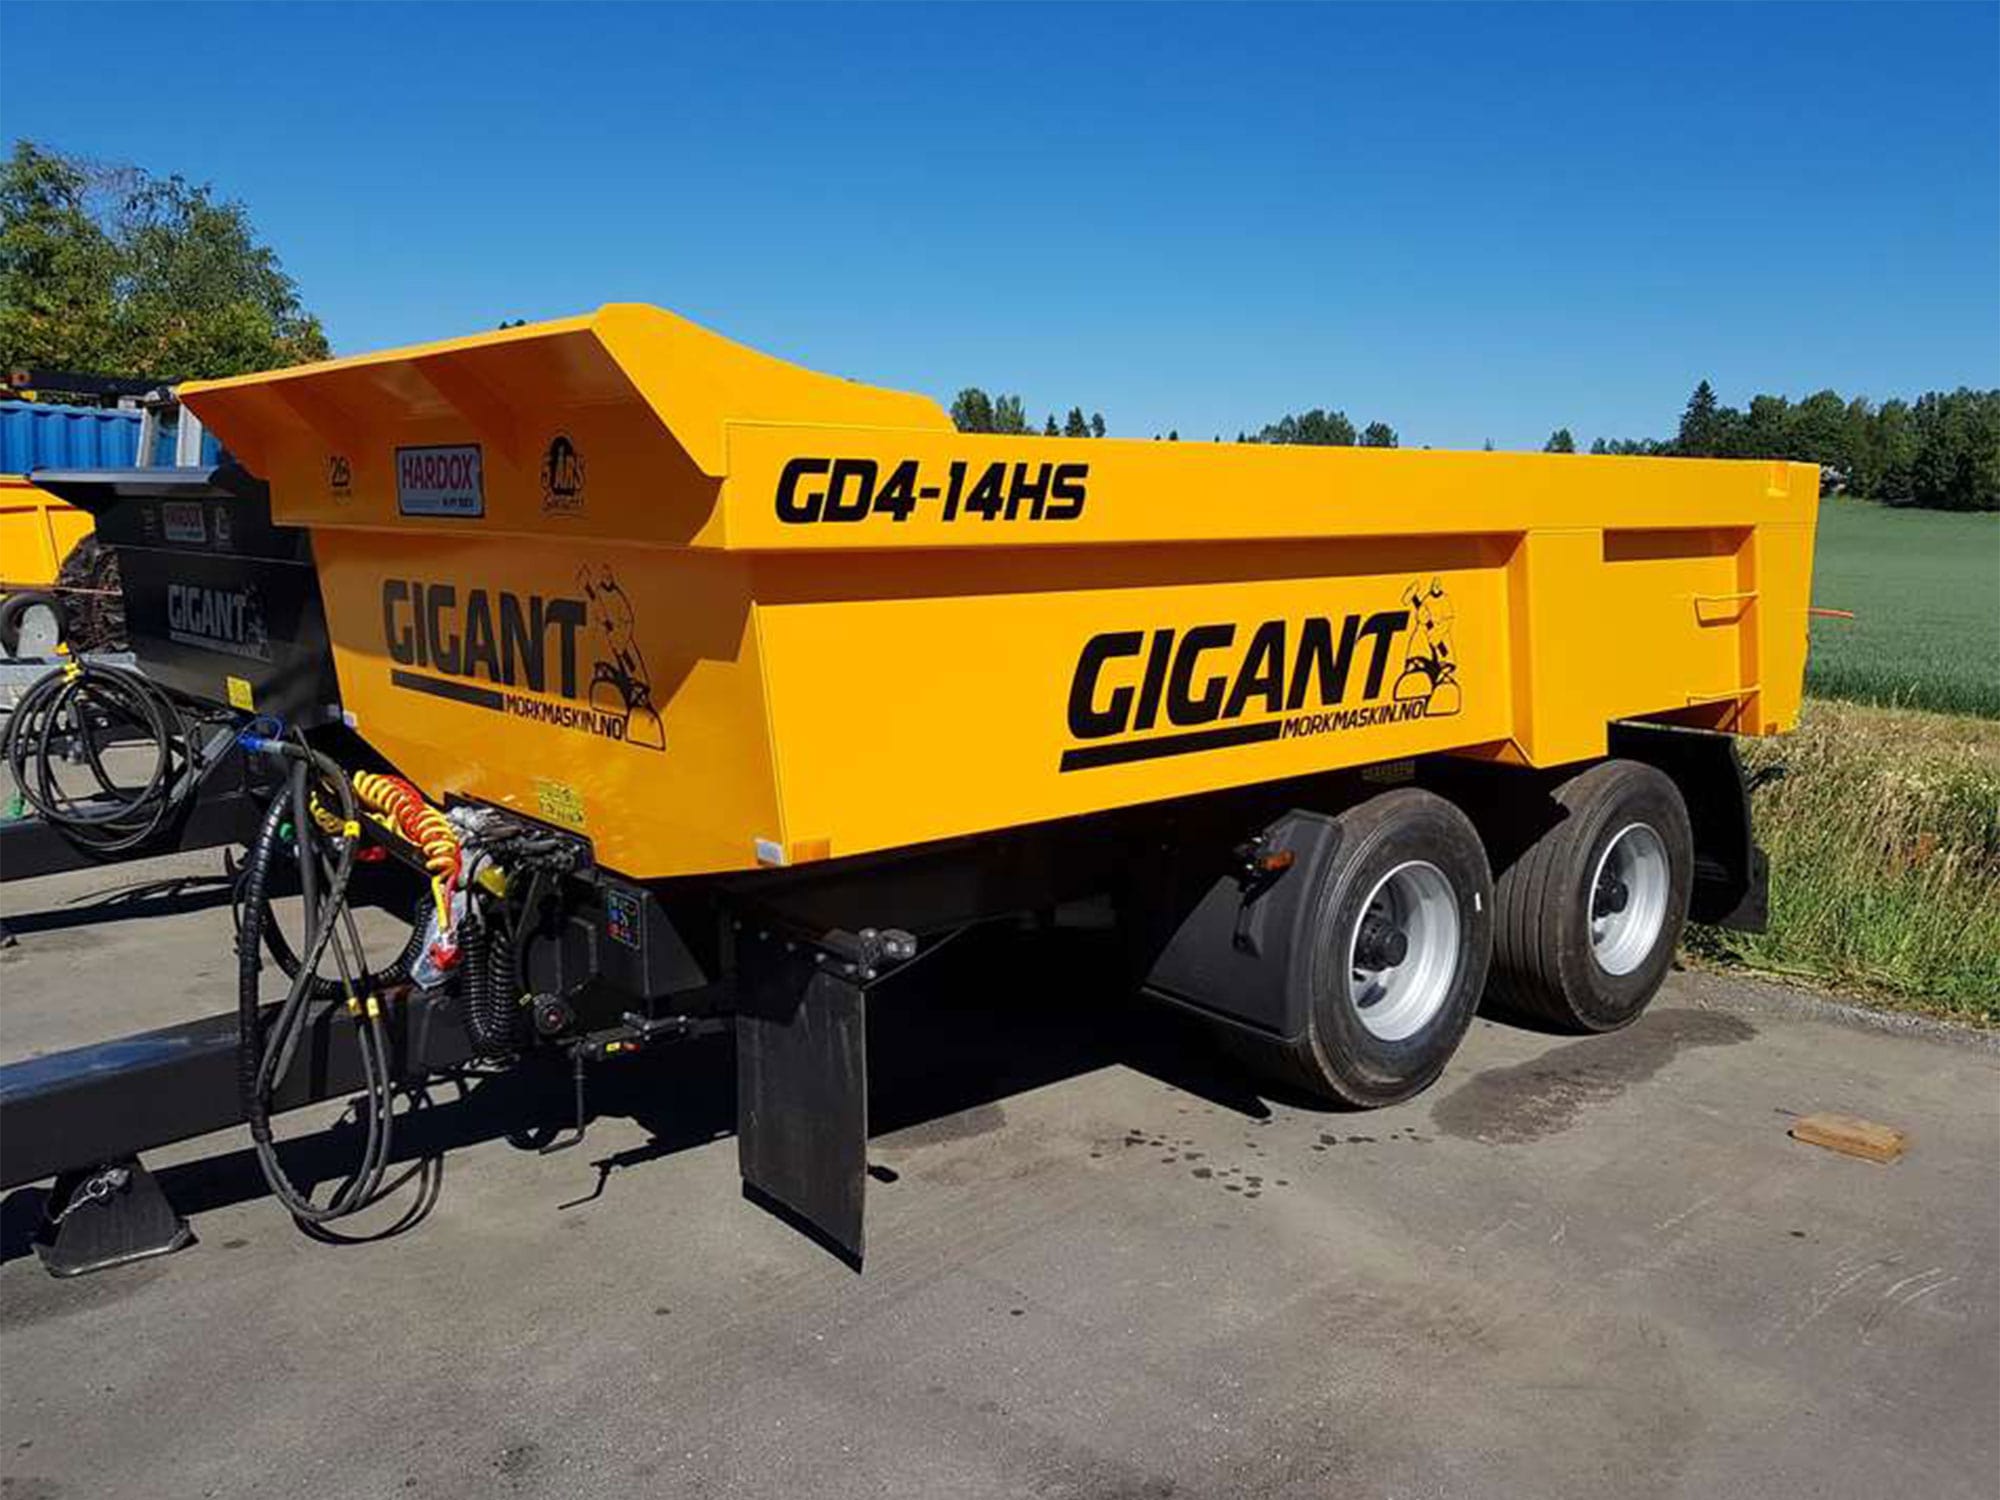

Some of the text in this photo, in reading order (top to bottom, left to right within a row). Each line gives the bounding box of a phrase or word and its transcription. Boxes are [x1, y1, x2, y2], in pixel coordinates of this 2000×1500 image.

[402, 454, 474, 490] HARDOX
[775, 457, 1089, 524] GD4-14HS
[168, 584, 246, 643] GIGANT
[383, 579, 587, 699] GIGANT
[1067, 610, 1410, 740] GIGANT
